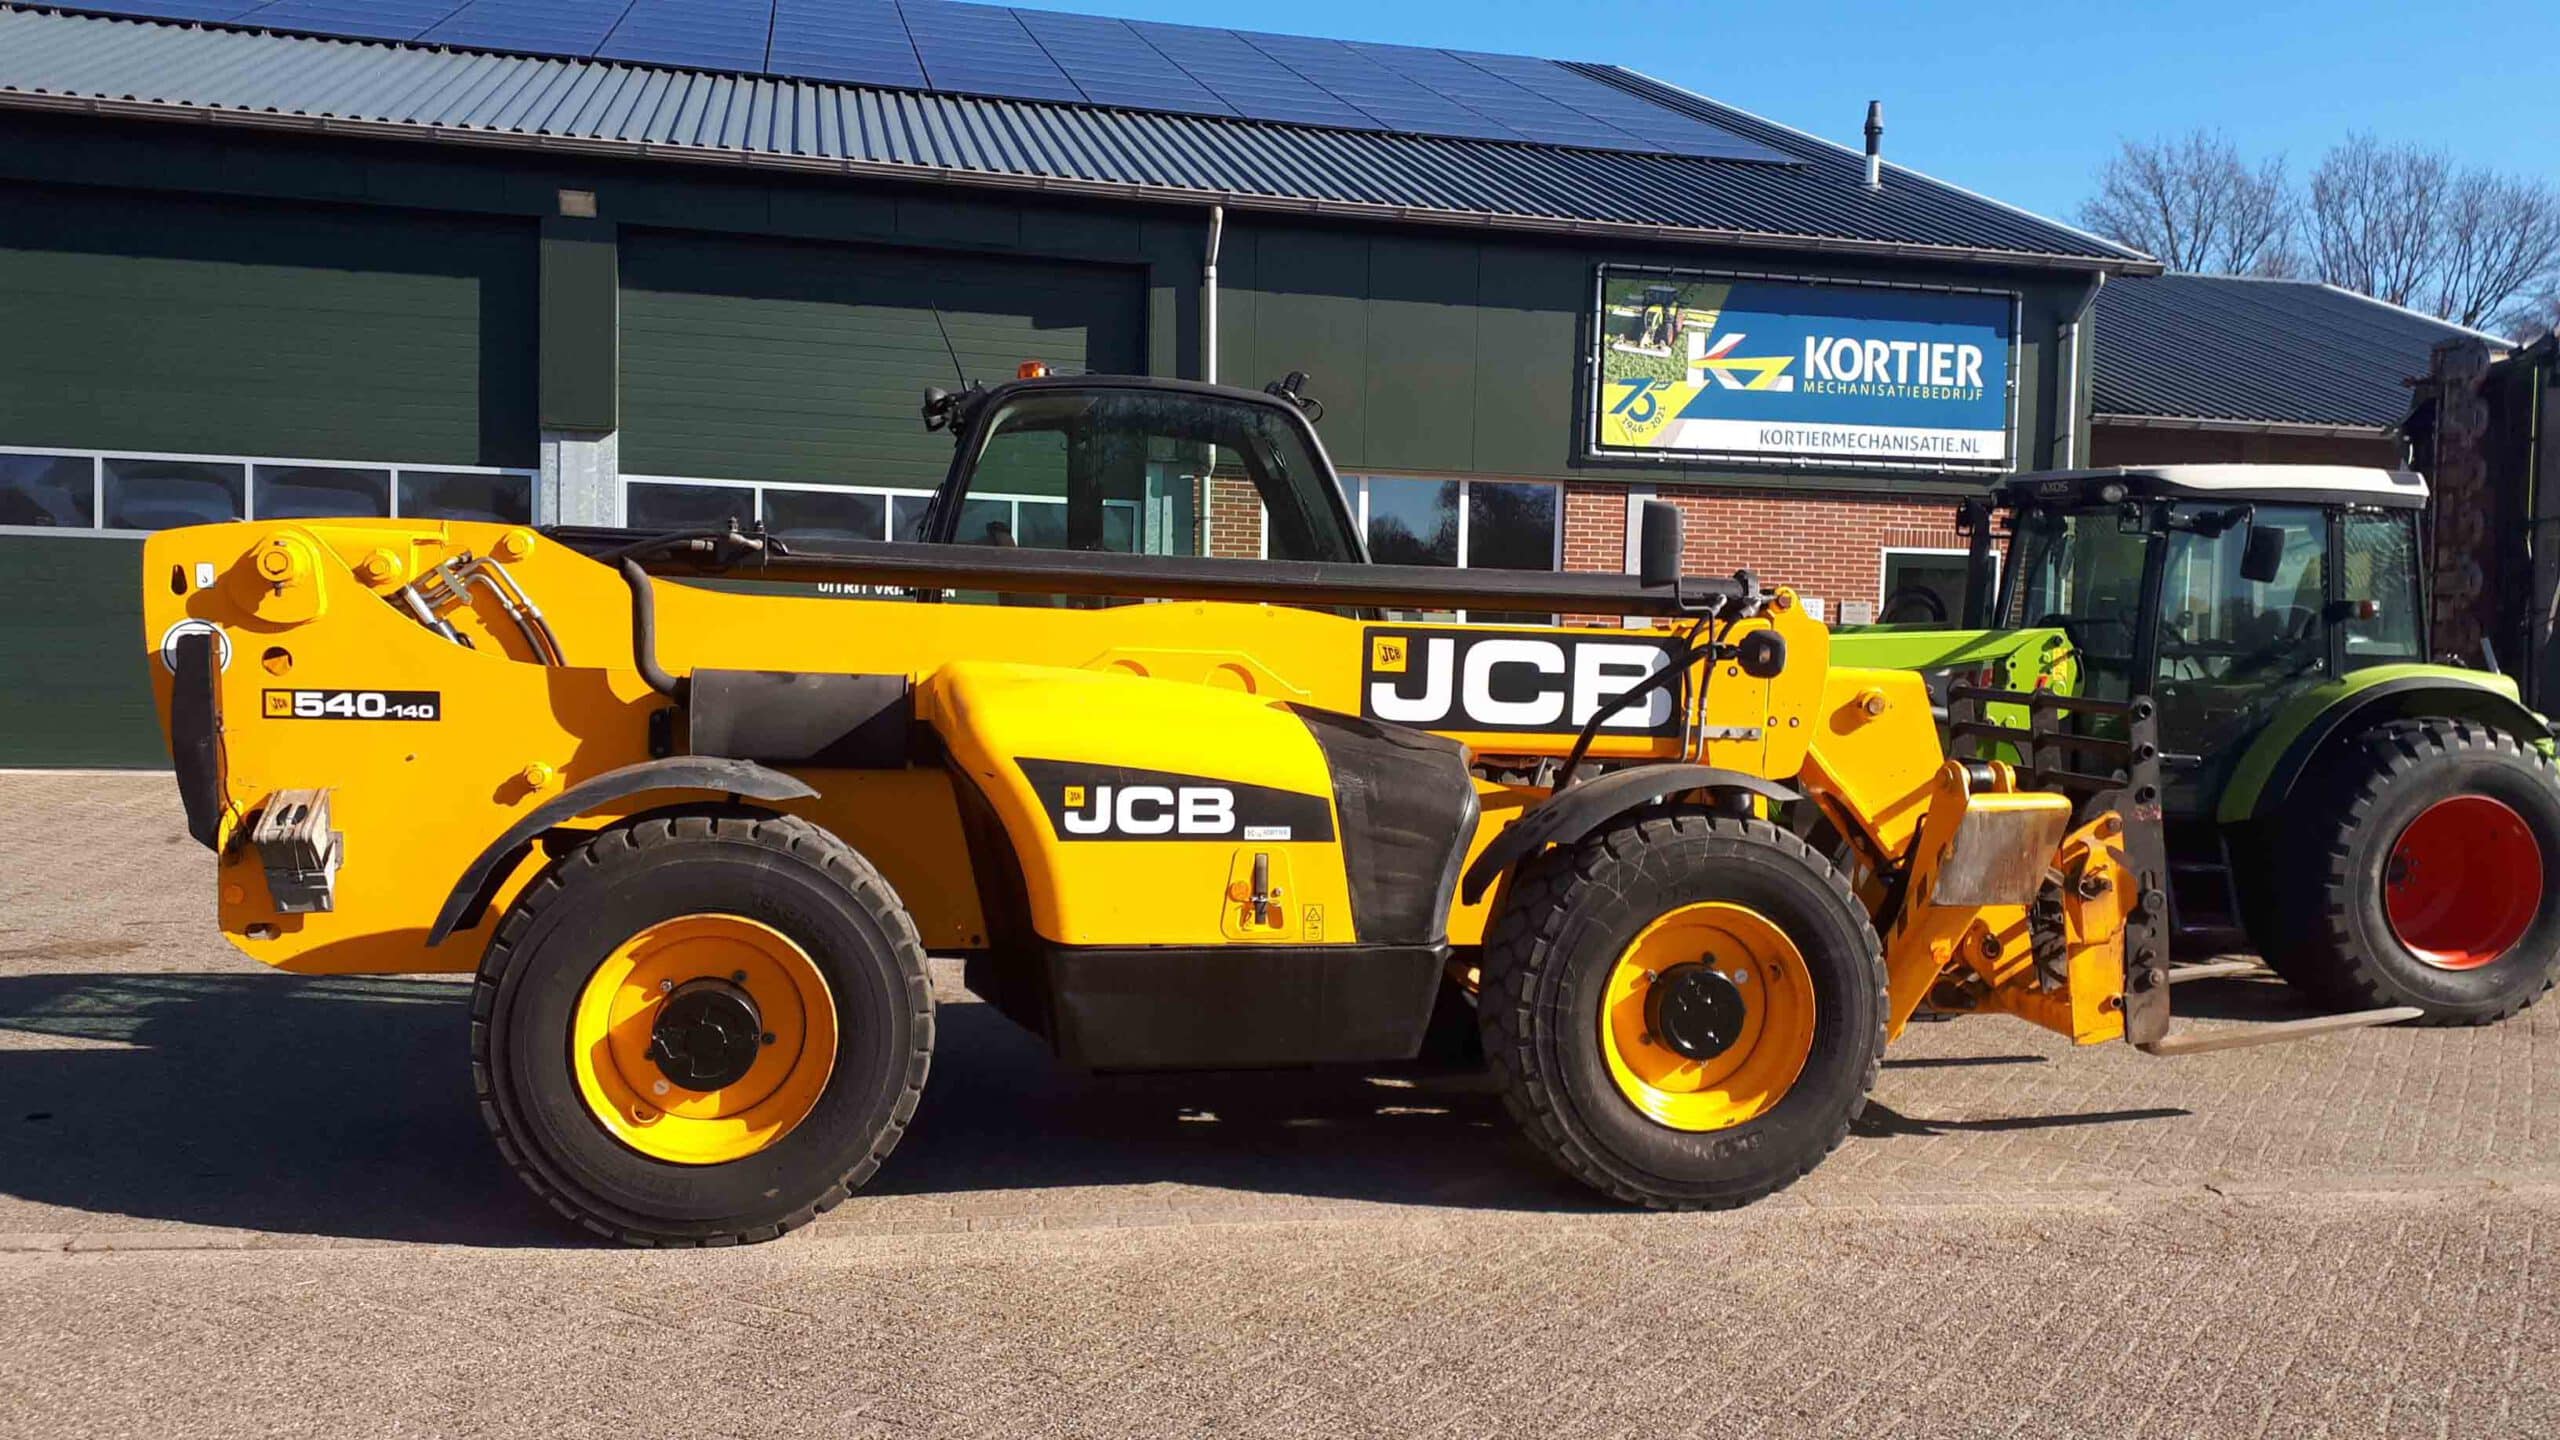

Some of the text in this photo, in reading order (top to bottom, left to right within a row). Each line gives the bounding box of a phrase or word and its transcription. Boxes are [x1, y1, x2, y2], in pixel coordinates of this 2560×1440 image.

[1804, 336, 1984, 387] KORTIER
[1803, 380, 1984, 401] MECHANISATIEBEDRIJF
[1759, 428, 1980, 453] KORTIERMECHANISATIE.NL
[1382, 645, 1401, 662] JCB
[1371, 638, 1673, 728] JCB
[294, 691, 434, 718] 540-140
[1064, 786, 1236, 834] JCB
